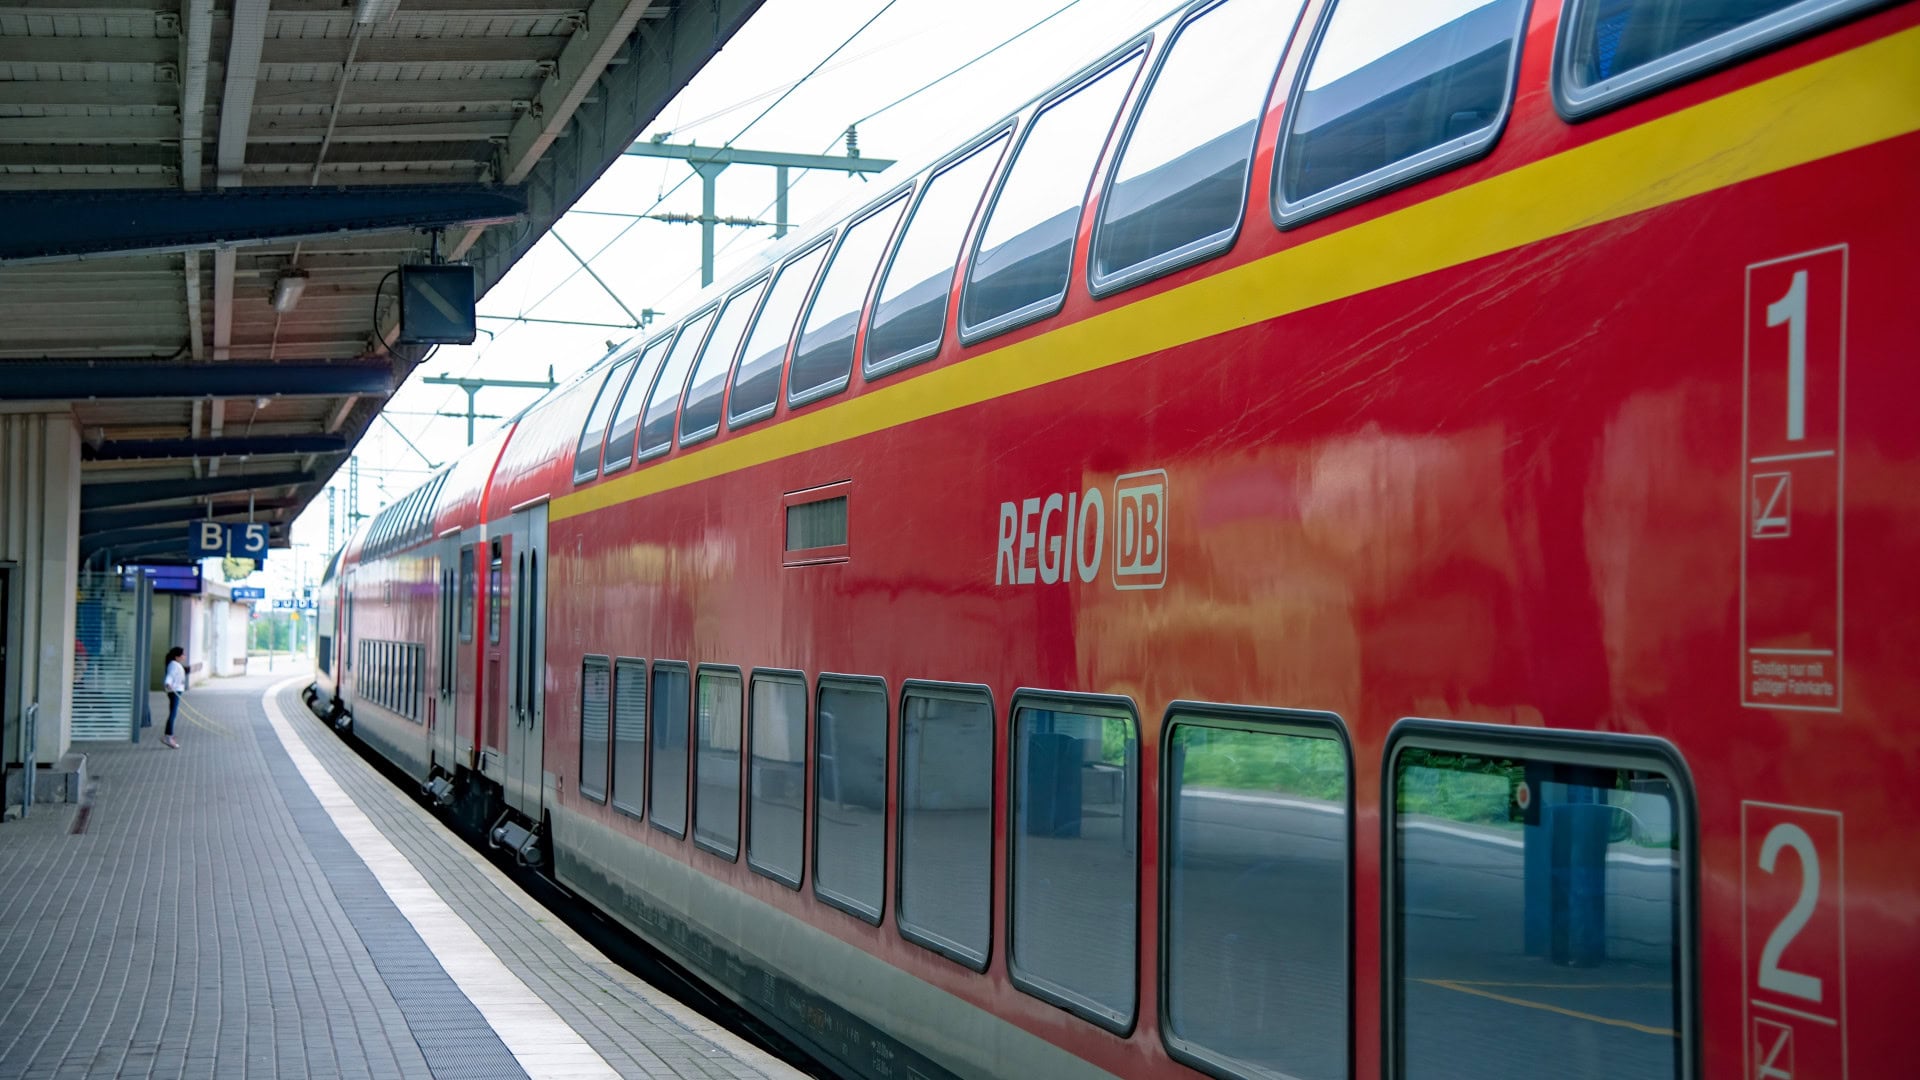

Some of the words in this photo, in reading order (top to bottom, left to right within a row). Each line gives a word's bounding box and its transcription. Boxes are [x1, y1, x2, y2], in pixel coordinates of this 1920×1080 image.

[1765, 269, 1809, 441] 1
[201, 522, 223, 550] B
[245, 524, 265, 552] 5
[995, 487, 1105, 585] REGIO
[1118, 488, 1162, 571] DB
[1752, 660, 1788, 679] Einstieg
[1757, 822, 1823, 1003] 2
